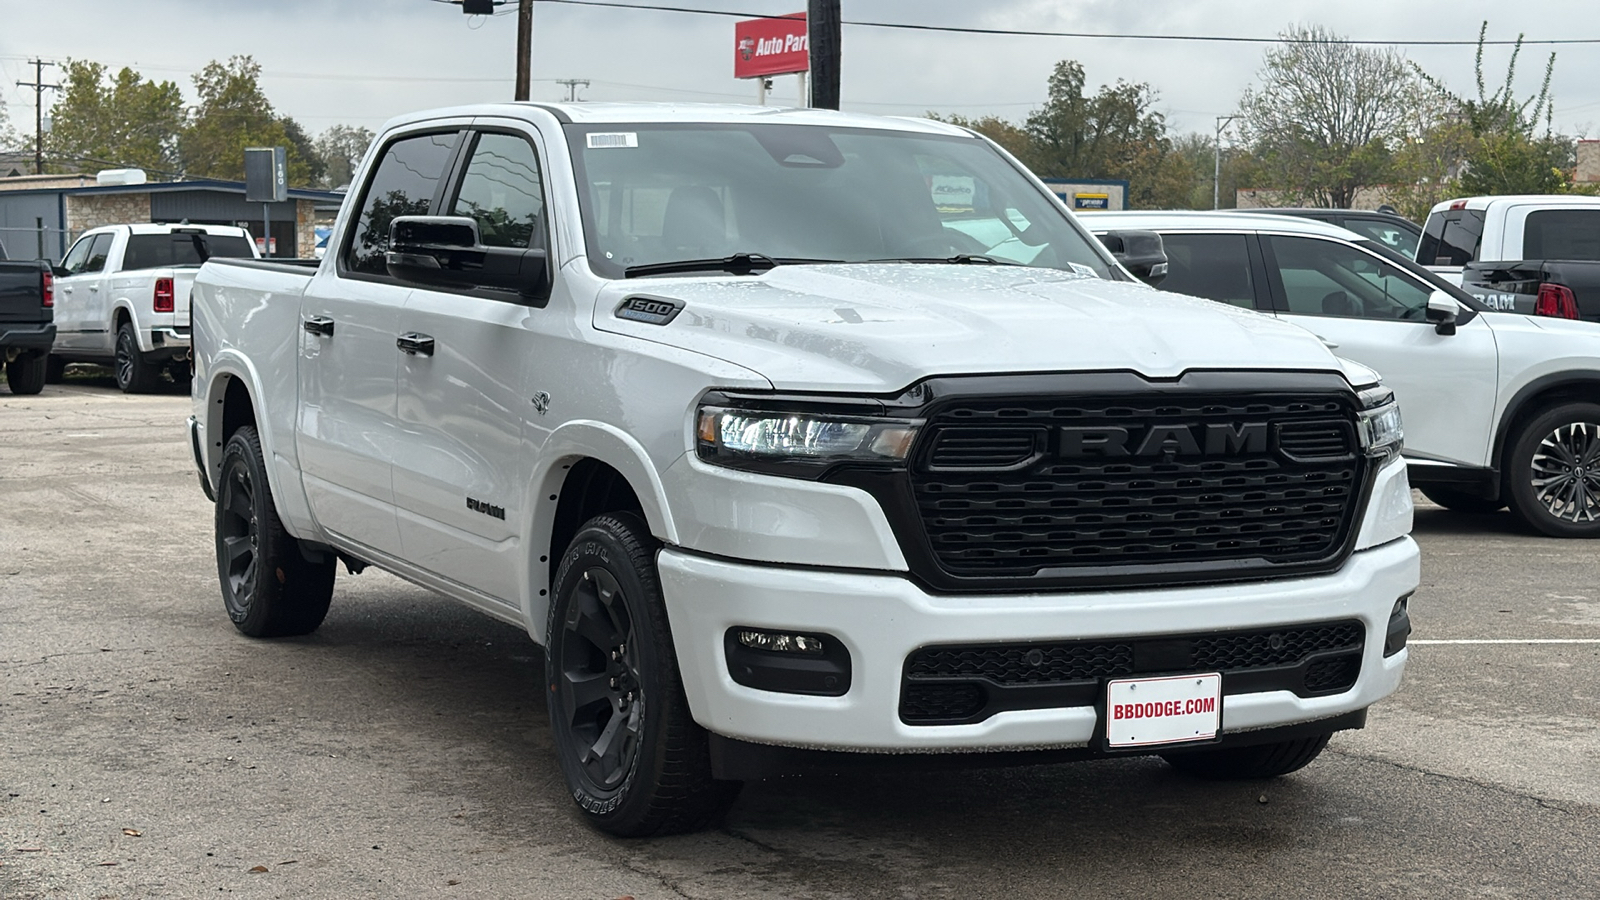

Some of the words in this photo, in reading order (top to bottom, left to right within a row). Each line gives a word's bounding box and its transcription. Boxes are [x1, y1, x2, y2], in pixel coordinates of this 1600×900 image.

[755, 37, 783, 56] Auto
[628, 300, 673, 315] 1500
[1060, 423, 1268, 456] RAM
[1113, 697, 1215, 720] BBDODGE.COM
